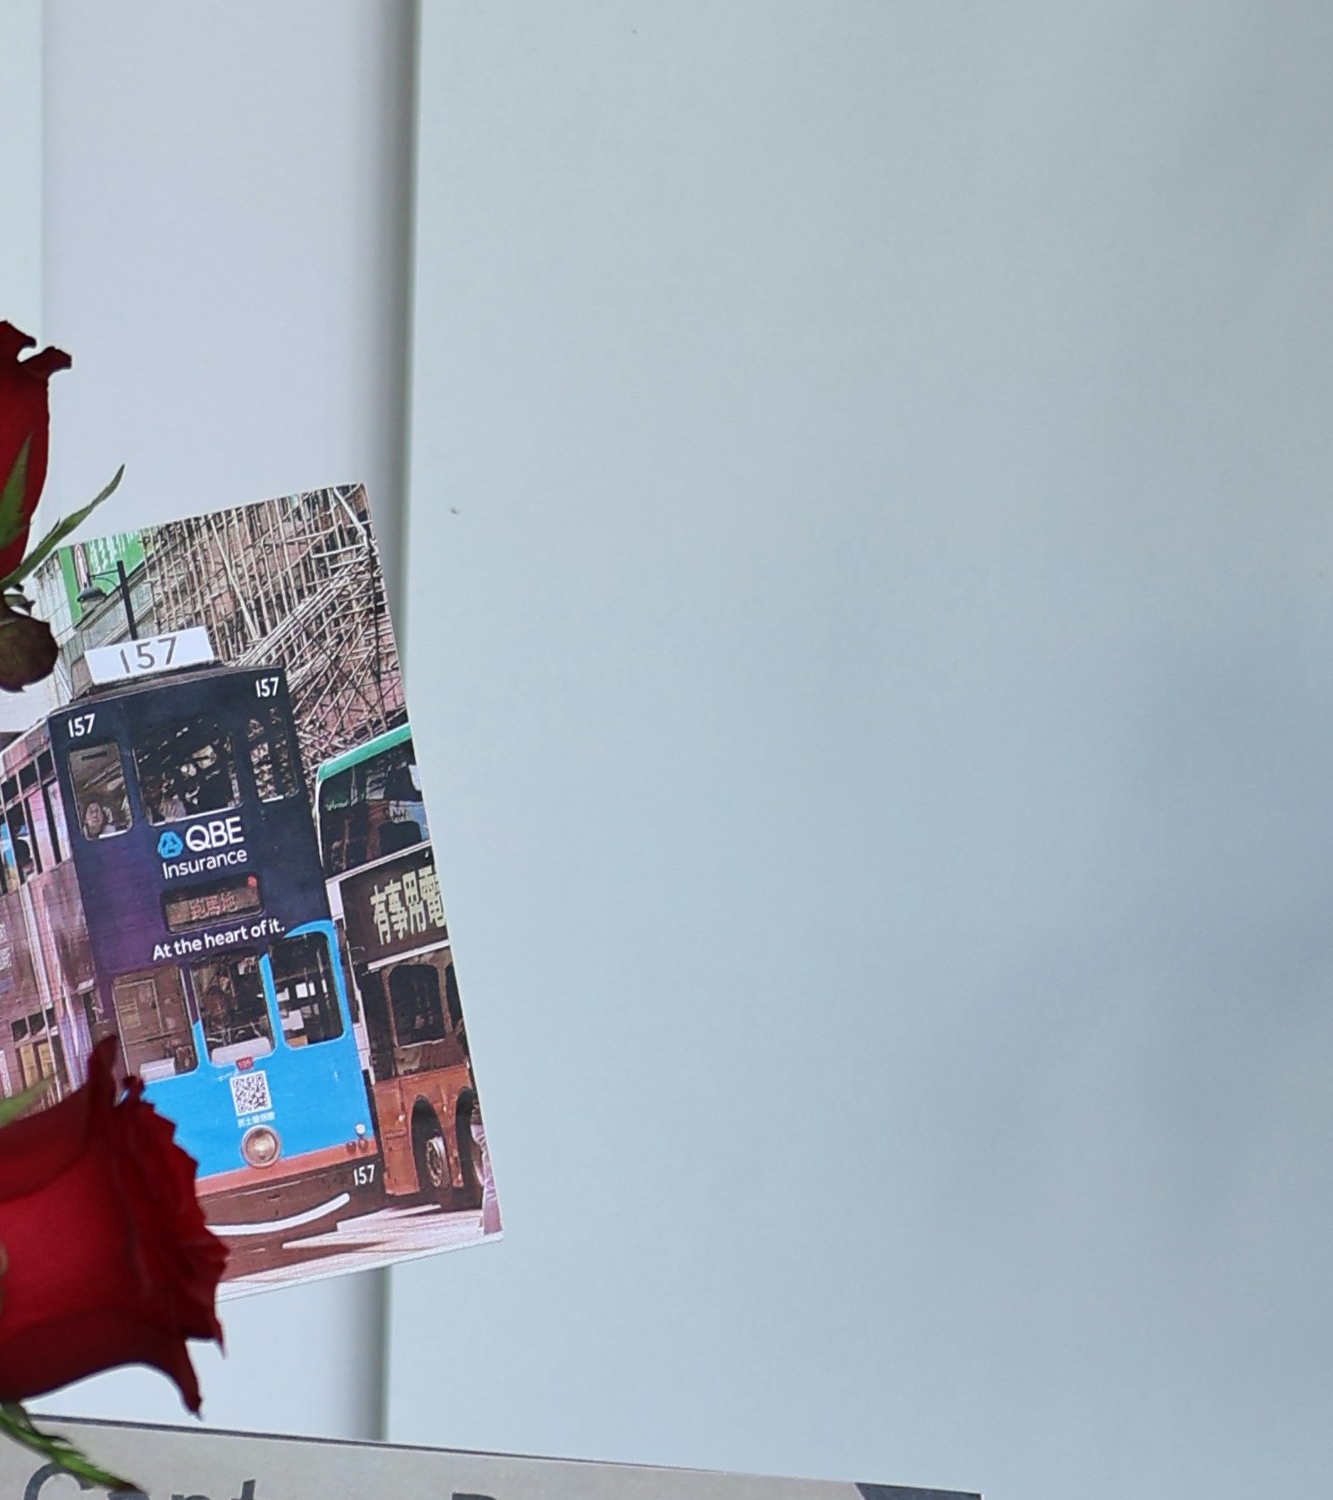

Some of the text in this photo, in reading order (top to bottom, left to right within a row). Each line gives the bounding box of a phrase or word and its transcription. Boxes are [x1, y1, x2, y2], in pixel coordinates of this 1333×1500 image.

[119, 636, 178, 674] 157
[255, 677, 279, 698] 157
[68, 713, 96, 738] 157
[185, 816, 245, 851] QBE
[162, 850, 247, 880] Insurance
[152, 943, 173, 961] At
[174, 935, 202, 956] the
[204, 924, 249, 949] heart
[250, 919, 269, 939] of
[353, 1164, 376, 1186] 157
